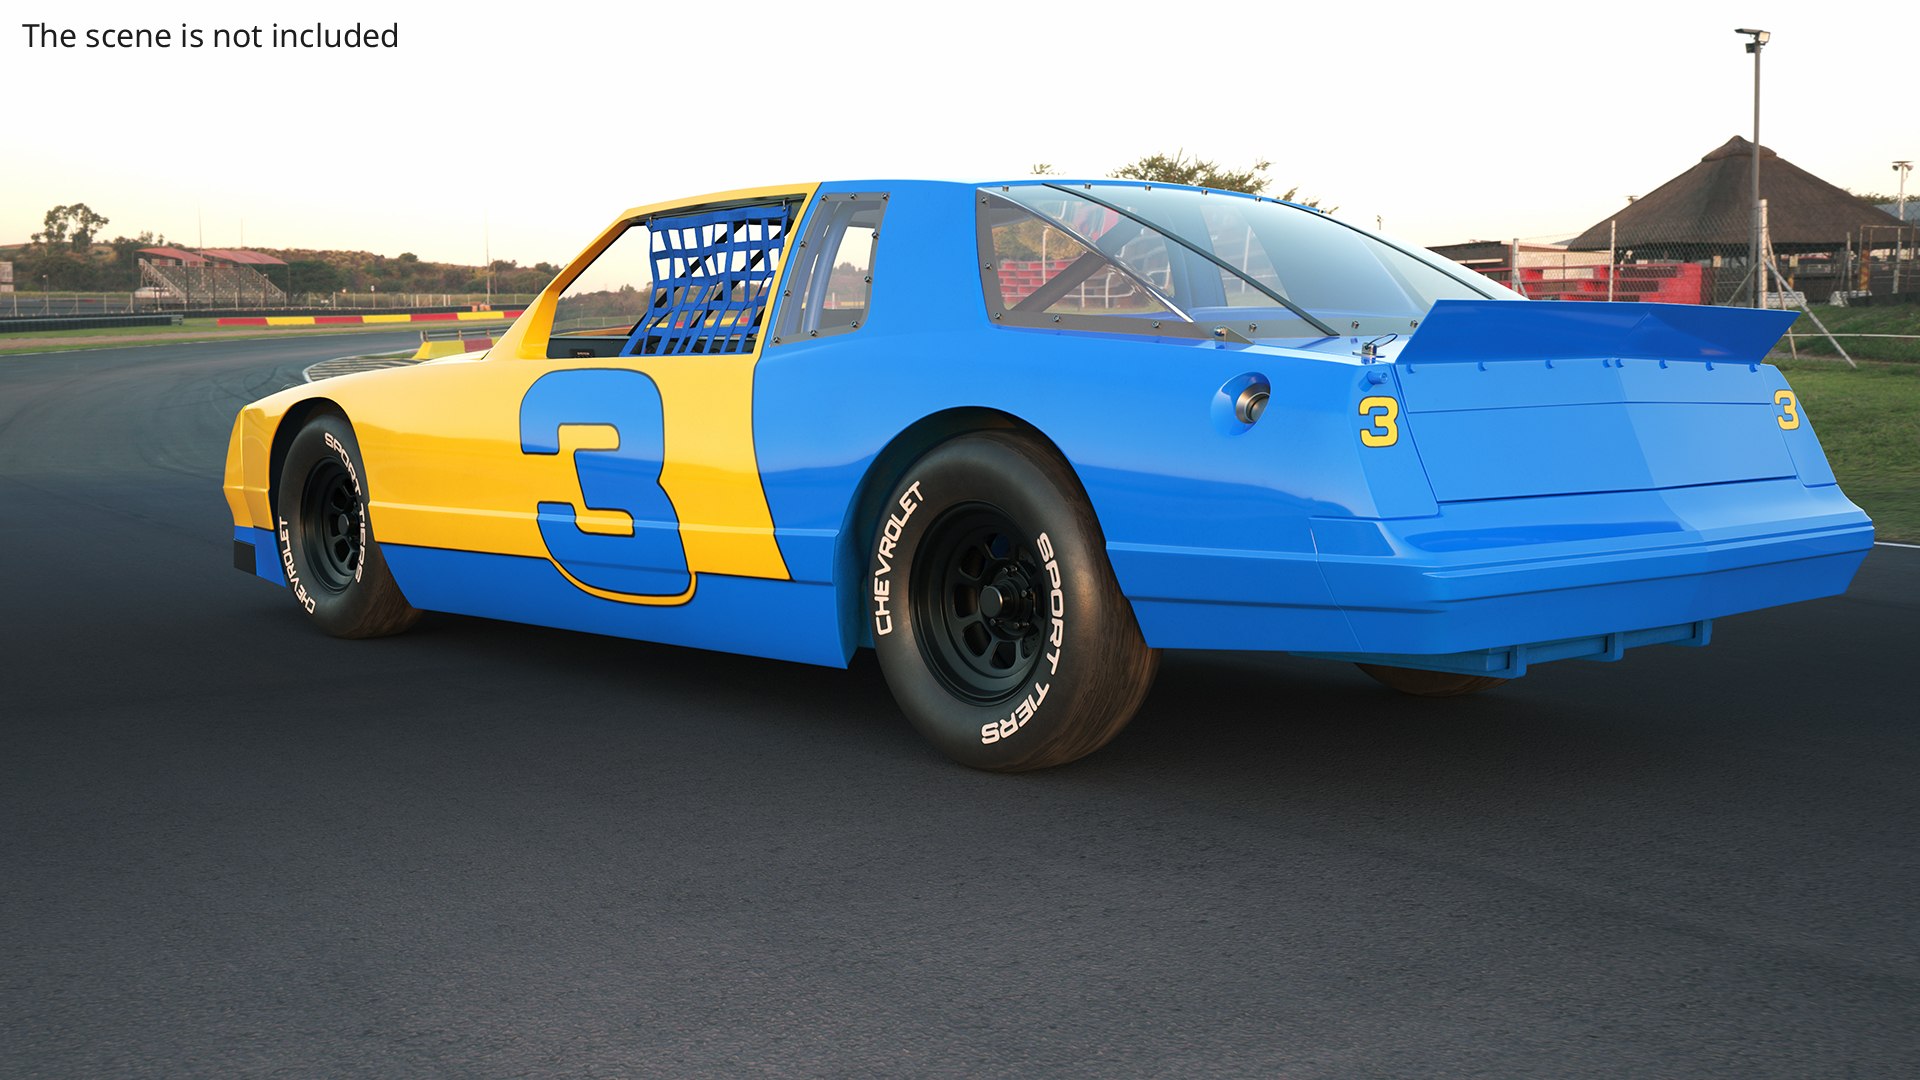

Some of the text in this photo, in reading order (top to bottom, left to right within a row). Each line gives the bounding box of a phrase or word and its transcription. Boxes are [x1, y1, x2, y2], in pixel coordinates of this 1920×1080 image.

[1358, 395, 1399, 448] 3
[1774, 389, 1800, 430] 3
[325, 432, 365, 583] SPORT TIERS
[519, 368, 695, 604] 3
[874, 480, 923, 636] CHEVROLET
[279, 516, 316, 614] CHEVROLET
[981, 532, 1064, 745] SPORT TIERS
